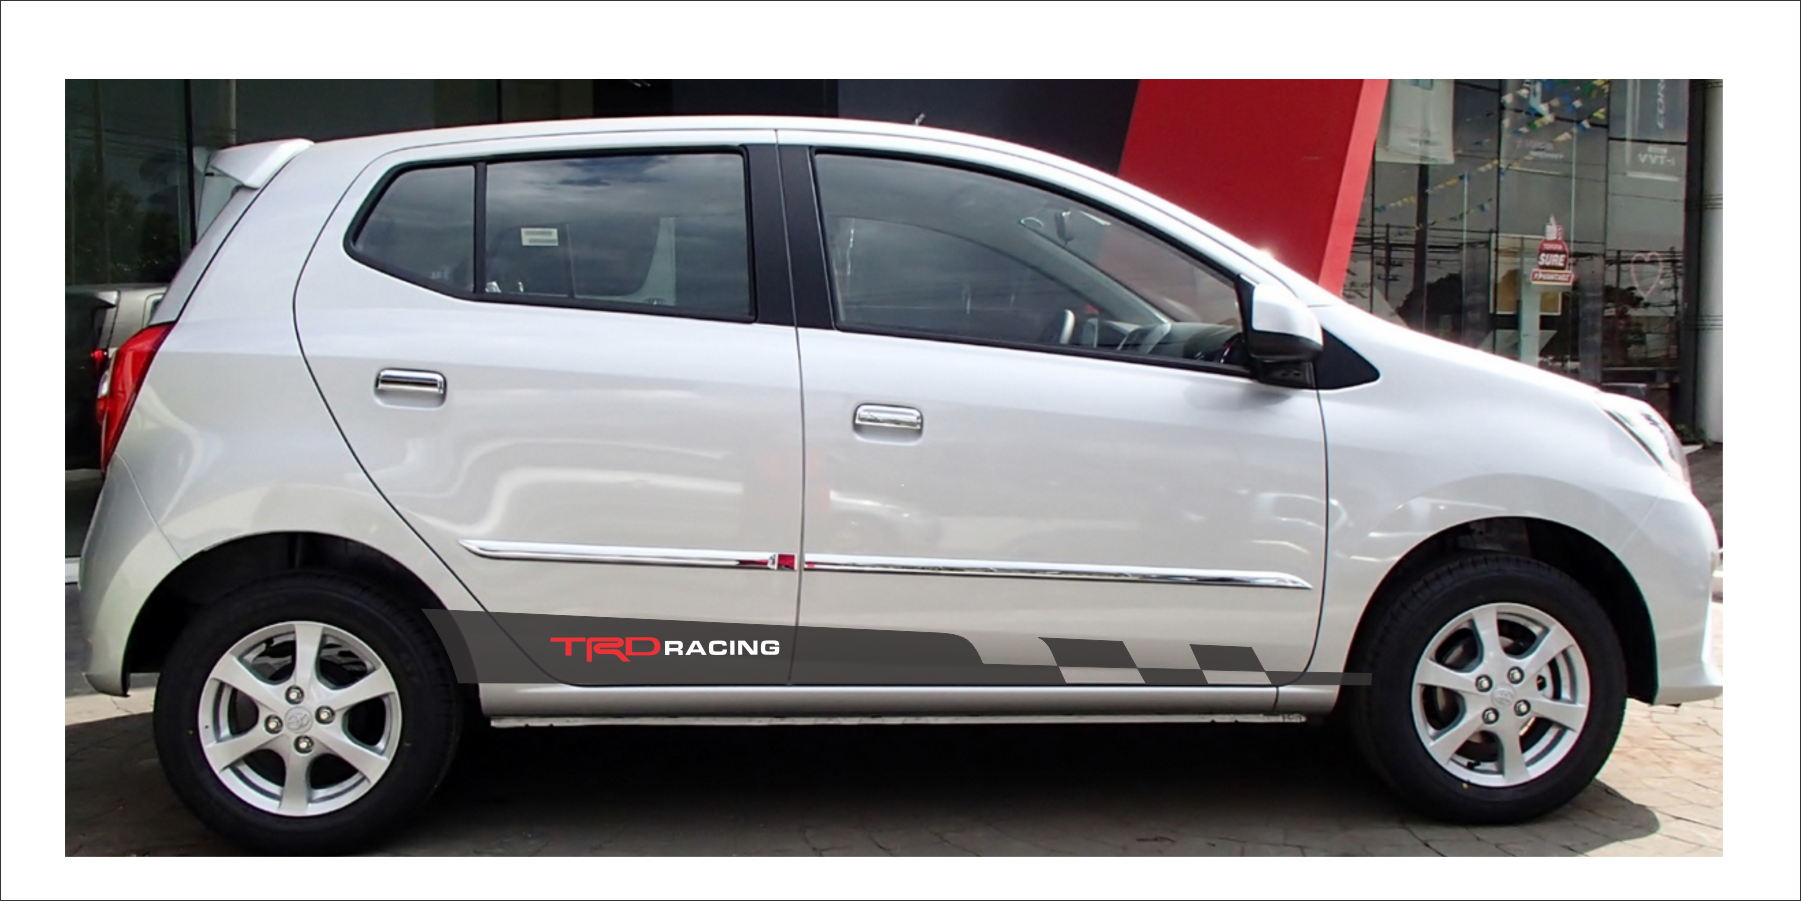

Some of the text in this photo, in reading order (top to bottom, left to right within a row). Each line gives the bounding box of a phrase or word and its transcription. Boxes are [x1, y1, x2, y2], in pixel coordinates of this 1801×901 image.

[1538, 252, 1566, 267] SURE
[550, 637, 780, 662] TRD RACING
